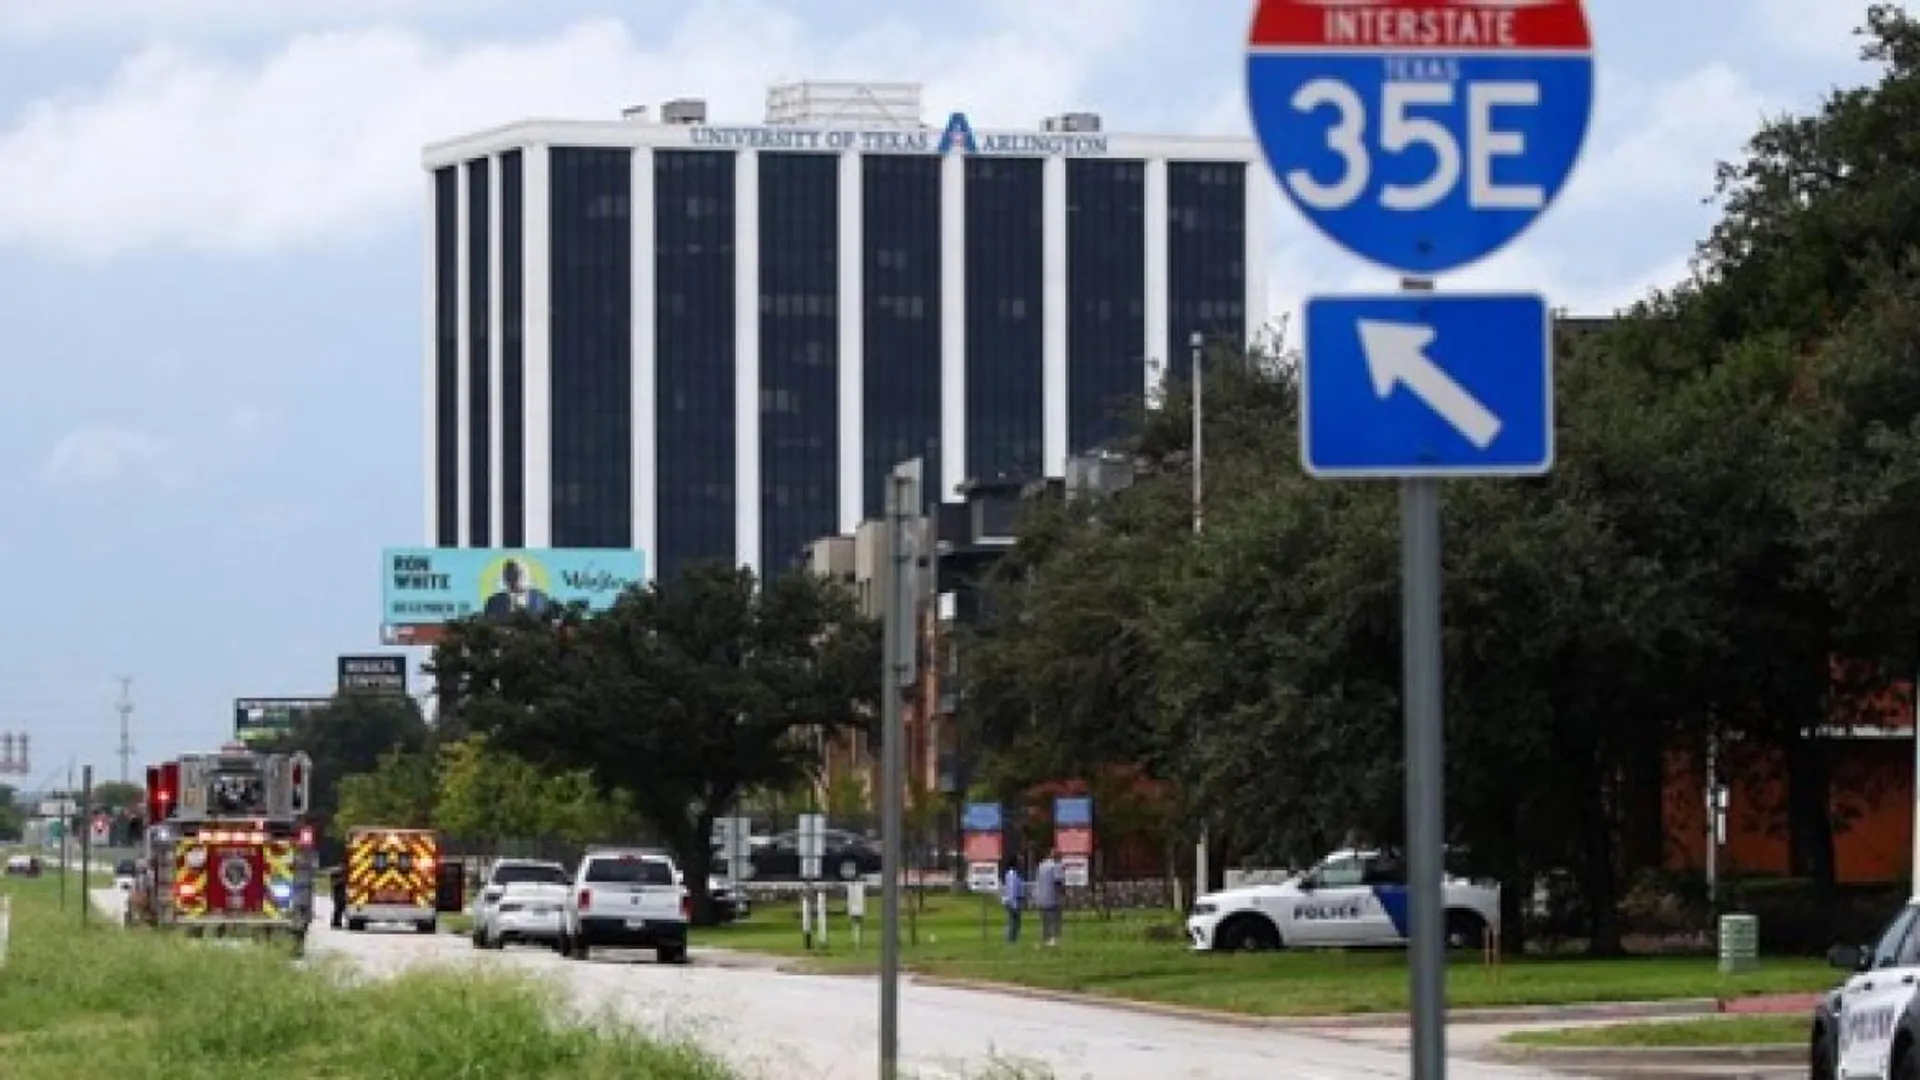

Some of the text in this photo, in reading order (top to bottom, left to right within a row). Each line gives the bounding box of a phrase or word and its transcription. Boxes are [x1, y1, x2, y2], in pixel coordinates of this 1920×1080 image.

[1323, 6, 1518, 43] INTERSTATE
[691, 127, 820, 148] UNIVERSITY
[826, 130, 856, 148] OF
[861, 131, 929, 150] TEXAS
[983, 133, 1108, 155] ARLINGTON
[1289, 79, 1545, 210] 35E
[393, 554, 430, 571] RON
[393, 573, 451, 590] WHITE
[1293, 906, 1360, 920] POLICE
